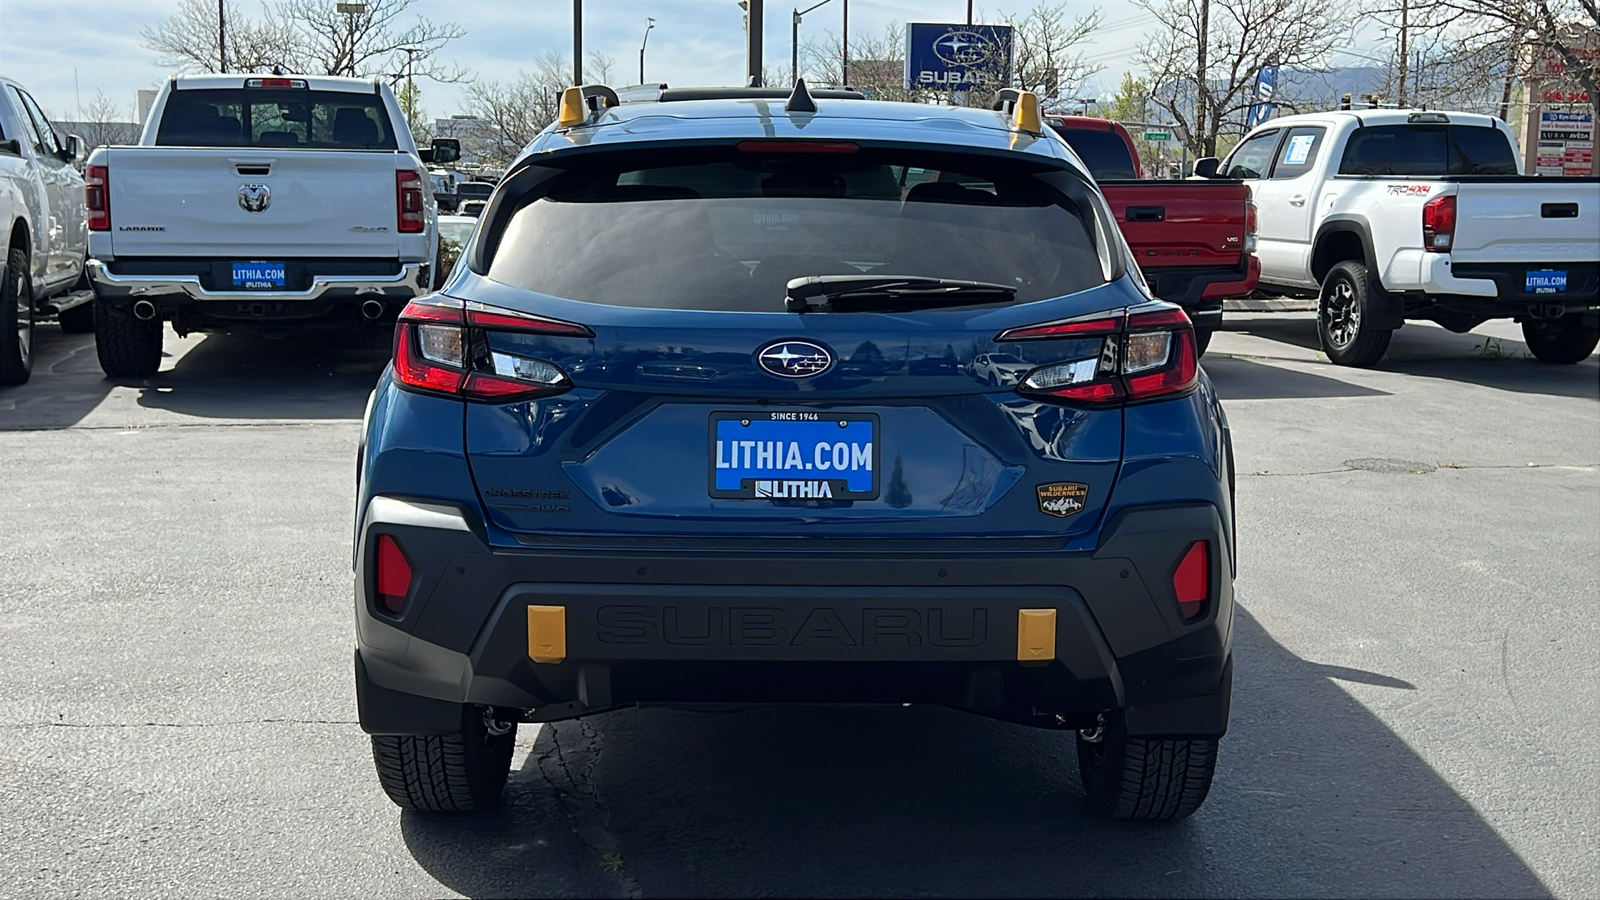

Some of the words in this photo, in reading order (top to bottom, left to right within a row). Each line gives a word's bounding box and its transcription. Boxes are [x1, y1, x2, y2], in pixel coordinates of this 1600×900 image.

[919, 70, 1004, 84] SUBAR
[232, 269, 285, 280] LITHIA.COM
[1525, 277, 1567, 287] LITHIA.COM
[771, 412, 797, 421] SINCE
[799, 413, 819, 421] 1946
[716, 440, 873, 471] LITHIA.COM
[484, 487, 572, 501] CROSSTREK
[773, 480, 833, 499] LITHIA
[596, 604, 989, 648] SUBARU
